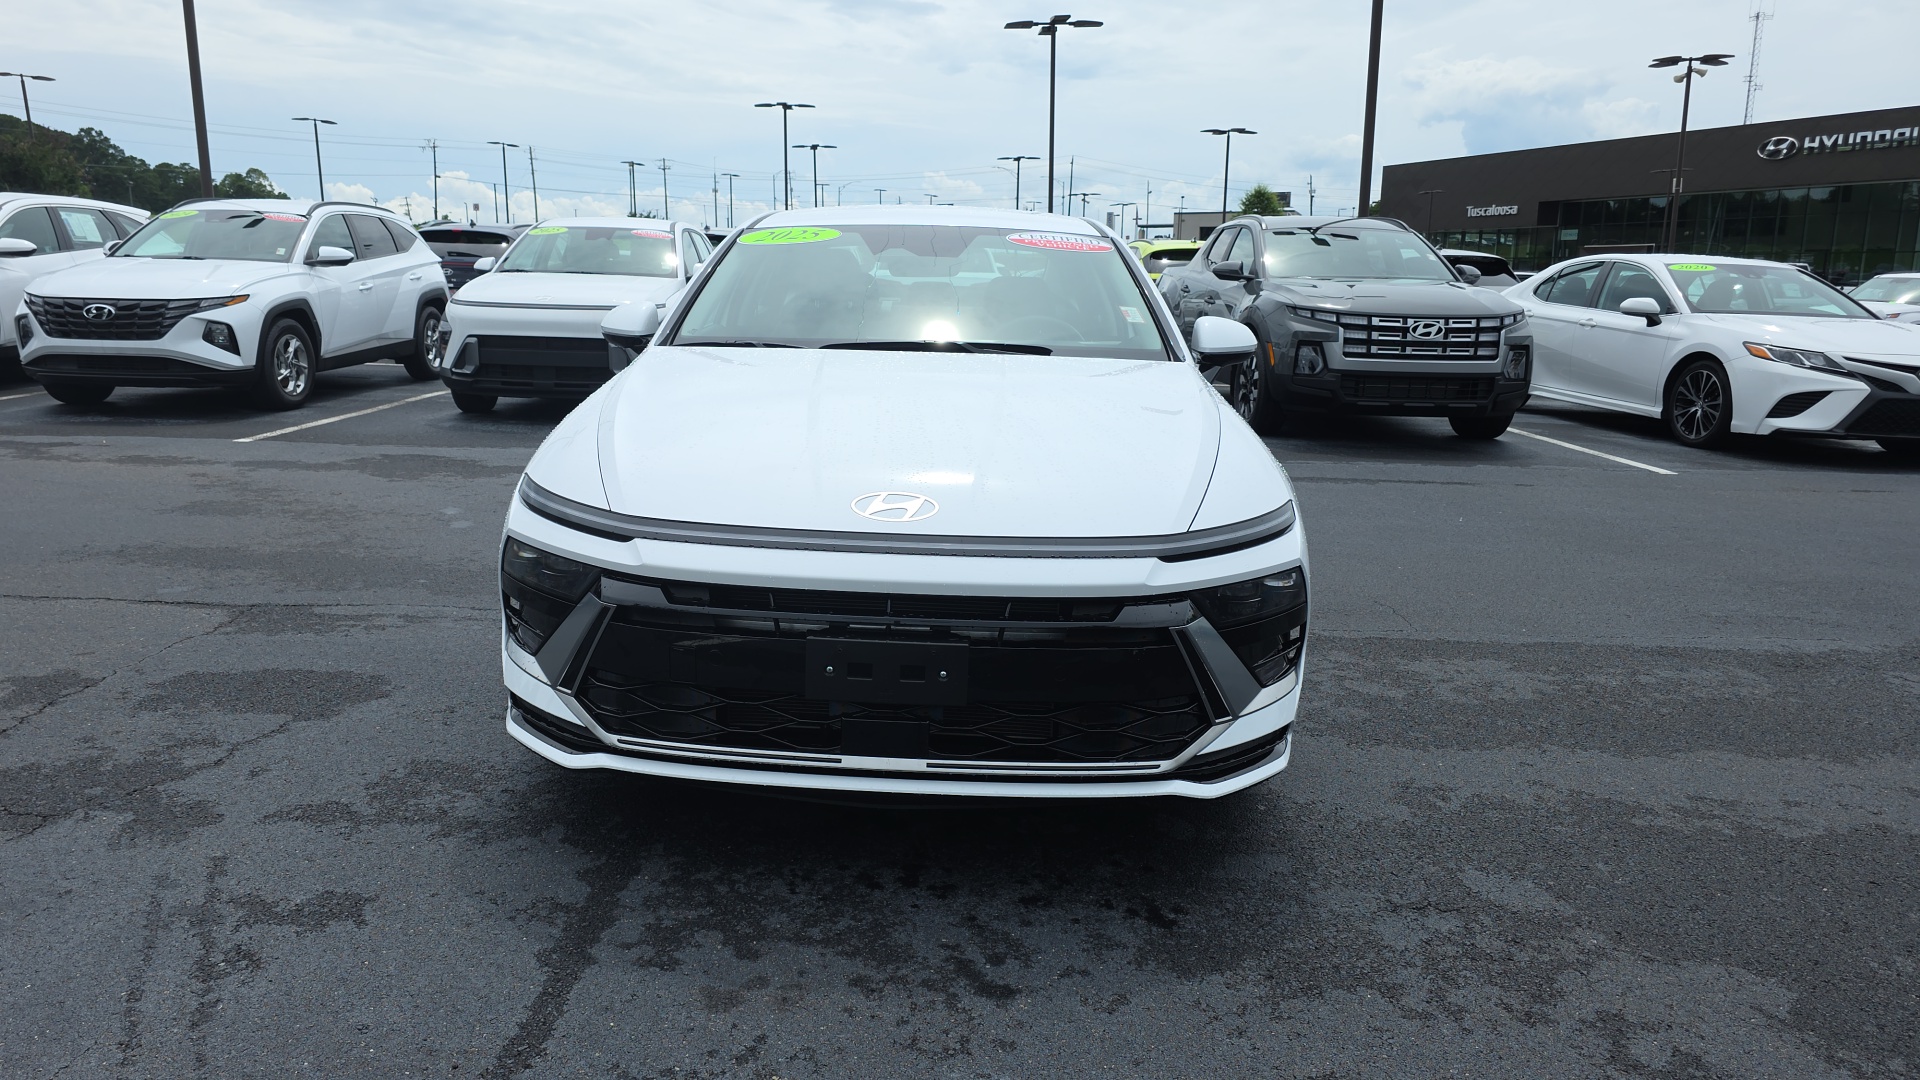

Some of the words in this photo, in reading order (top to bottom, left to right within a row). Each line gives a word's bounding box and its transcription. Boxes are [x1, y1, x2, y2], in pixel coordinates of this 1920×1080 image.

[1803, 126, 1919, 155] HYUNDAI
[1466, 204, 1518, 217] Tuscaloosa
[752, 229, 828, 243] 2025
[1018, 233, 1102, 246] CERTIFIED
